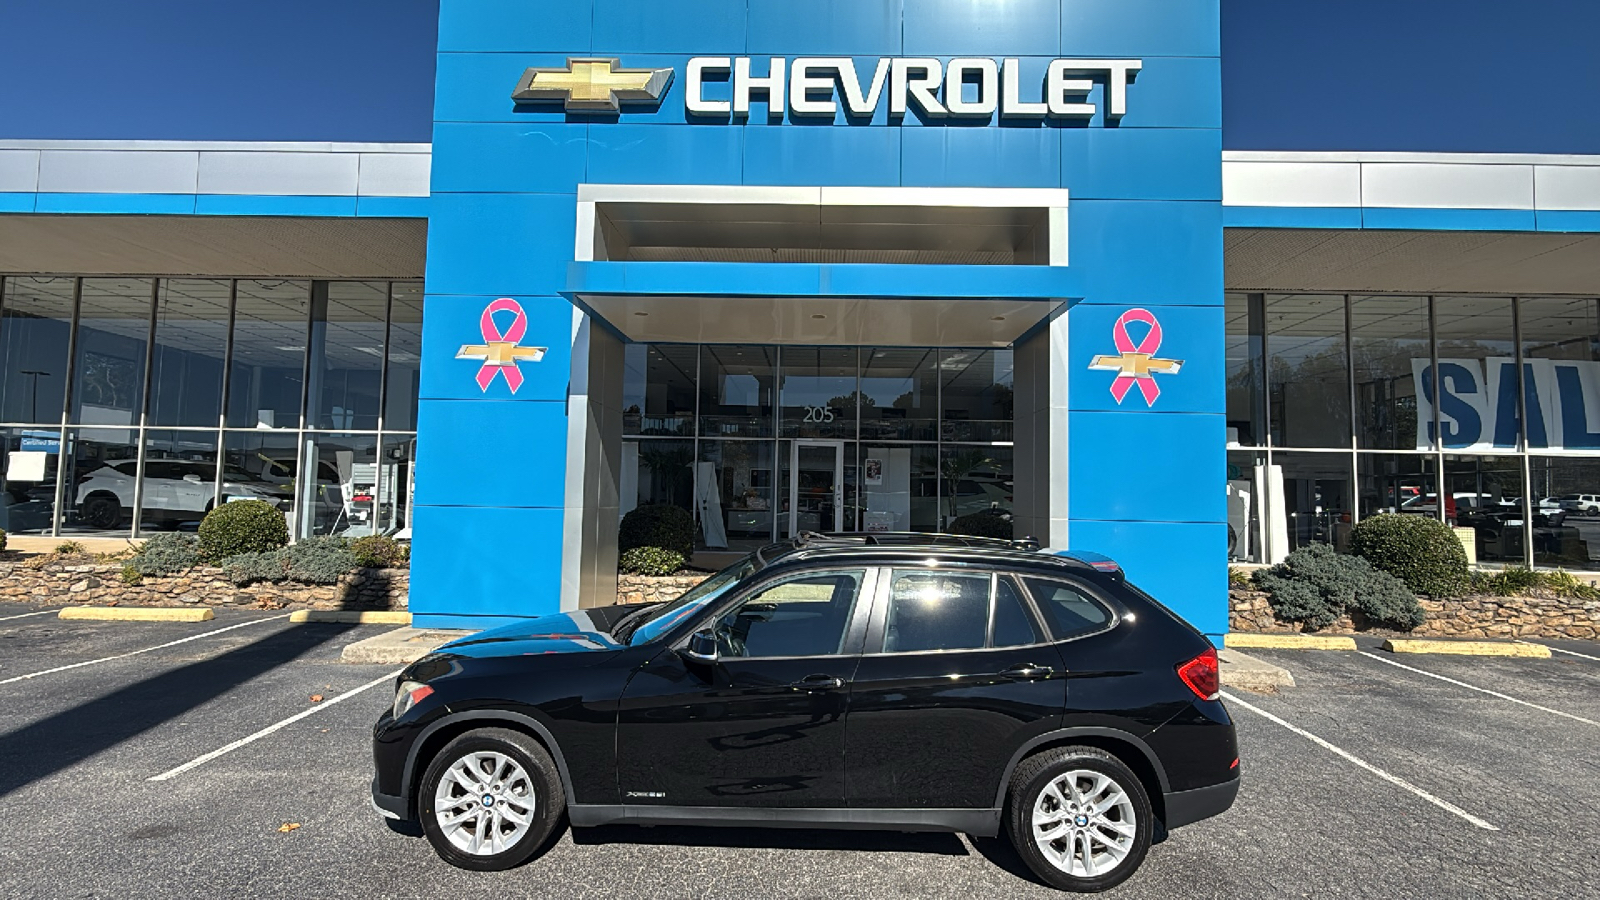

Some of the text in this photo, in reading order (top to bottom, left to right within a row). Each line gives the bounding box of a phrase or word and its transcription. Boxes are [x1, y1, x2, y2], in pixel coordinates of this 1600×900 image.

[685, 56, 1143, 119] CHEVROLET
[802, 406, 834, 423] 205
[1421, 362, 1600, 450] SAL
